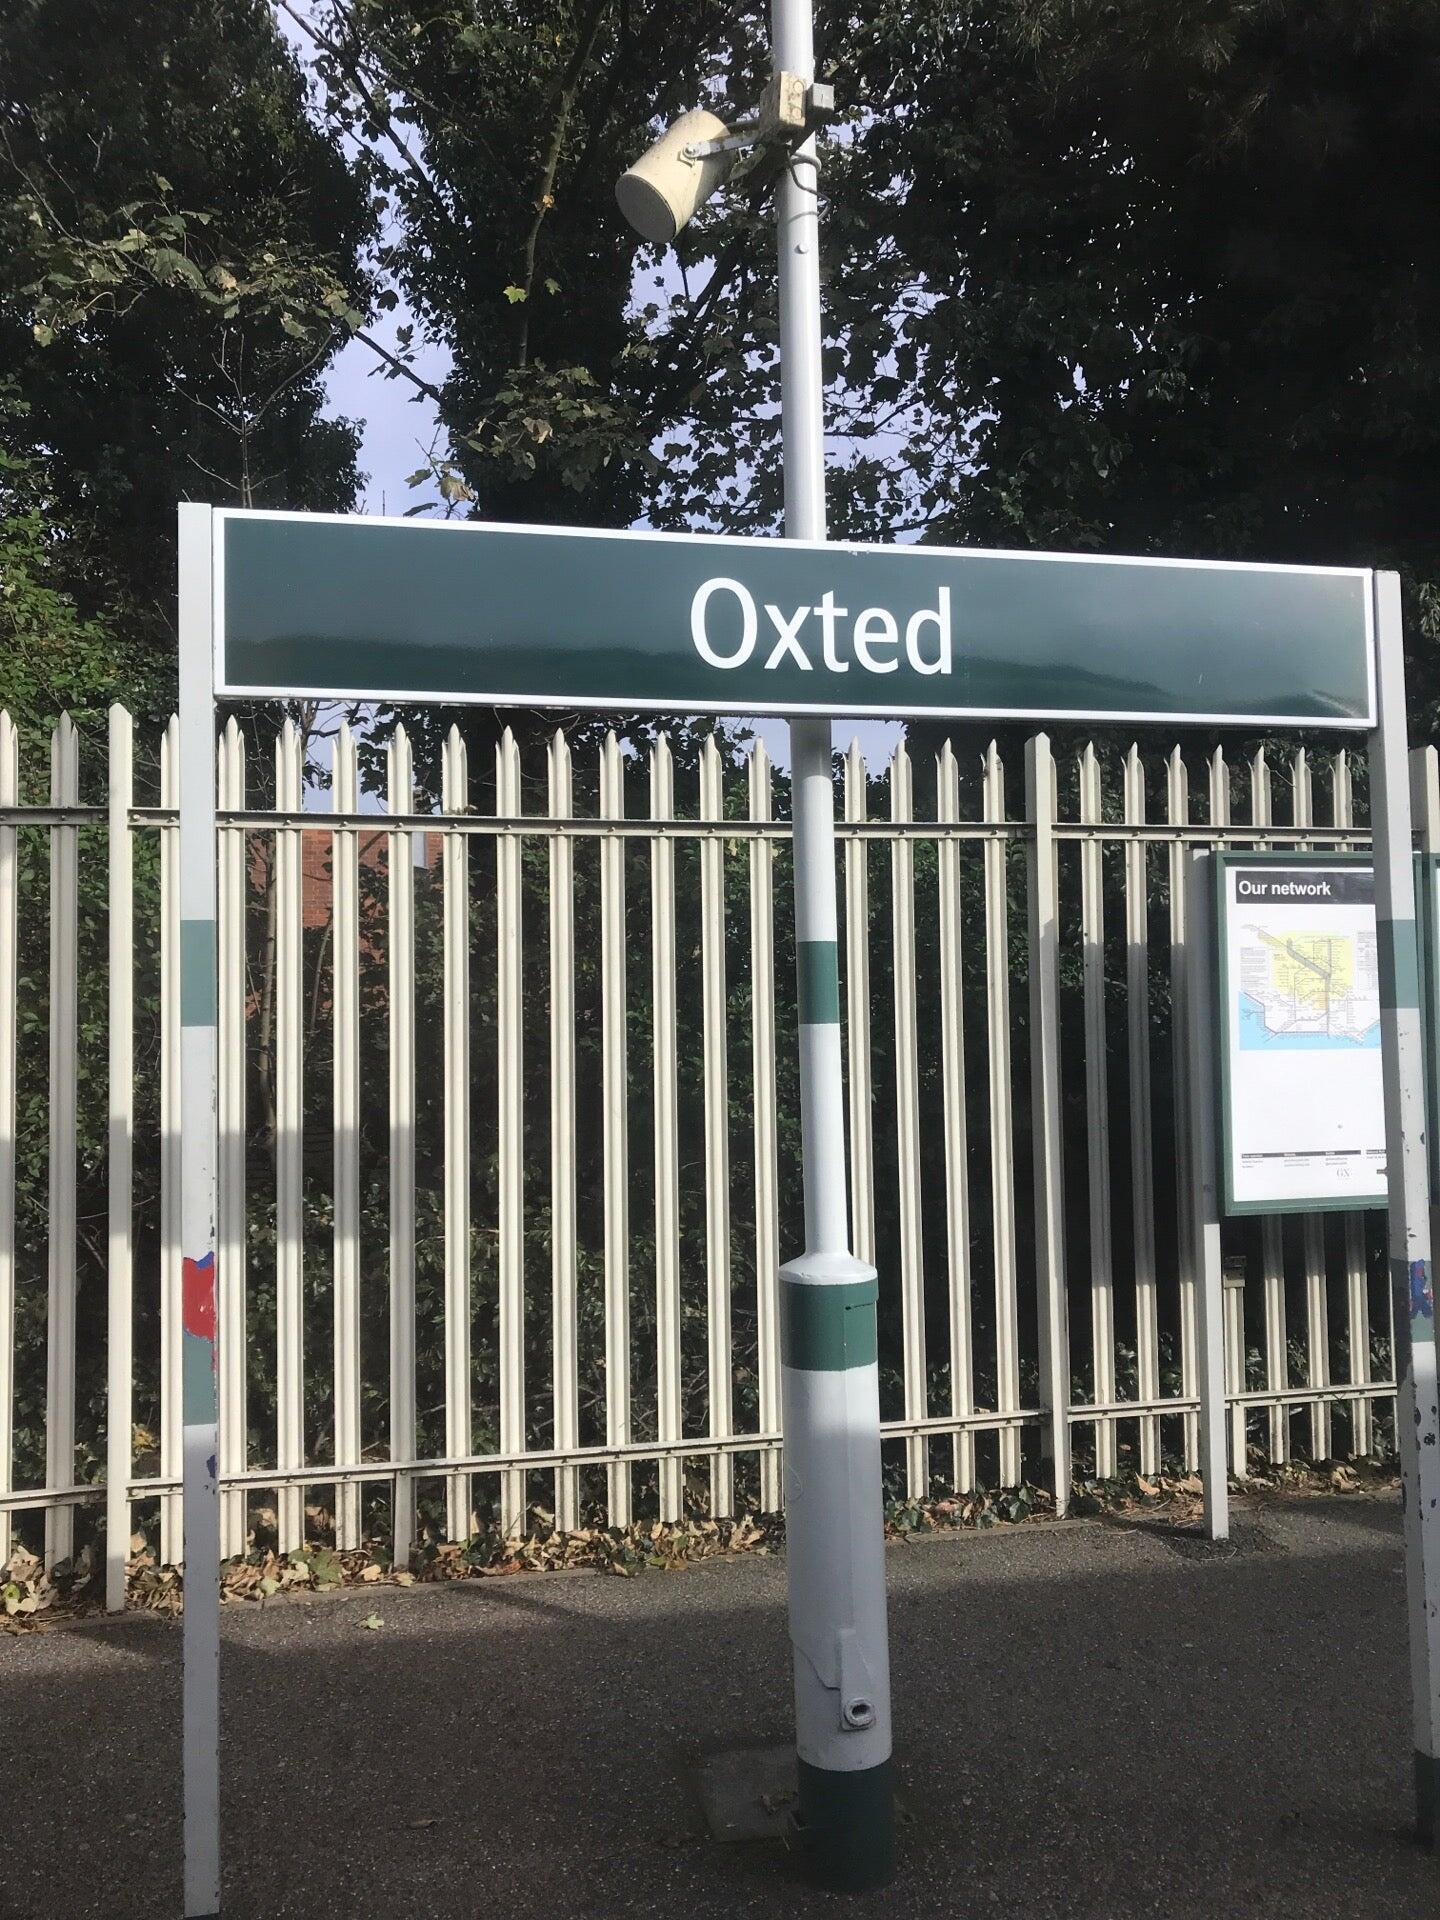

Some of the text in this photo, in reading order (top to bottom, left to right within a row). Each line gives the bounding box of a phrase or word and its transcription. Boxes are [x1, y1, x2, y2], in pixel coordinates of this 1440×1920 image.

[690, 577, 952, 675] Oxted
[1238, 881, 1331, 896] Our network
